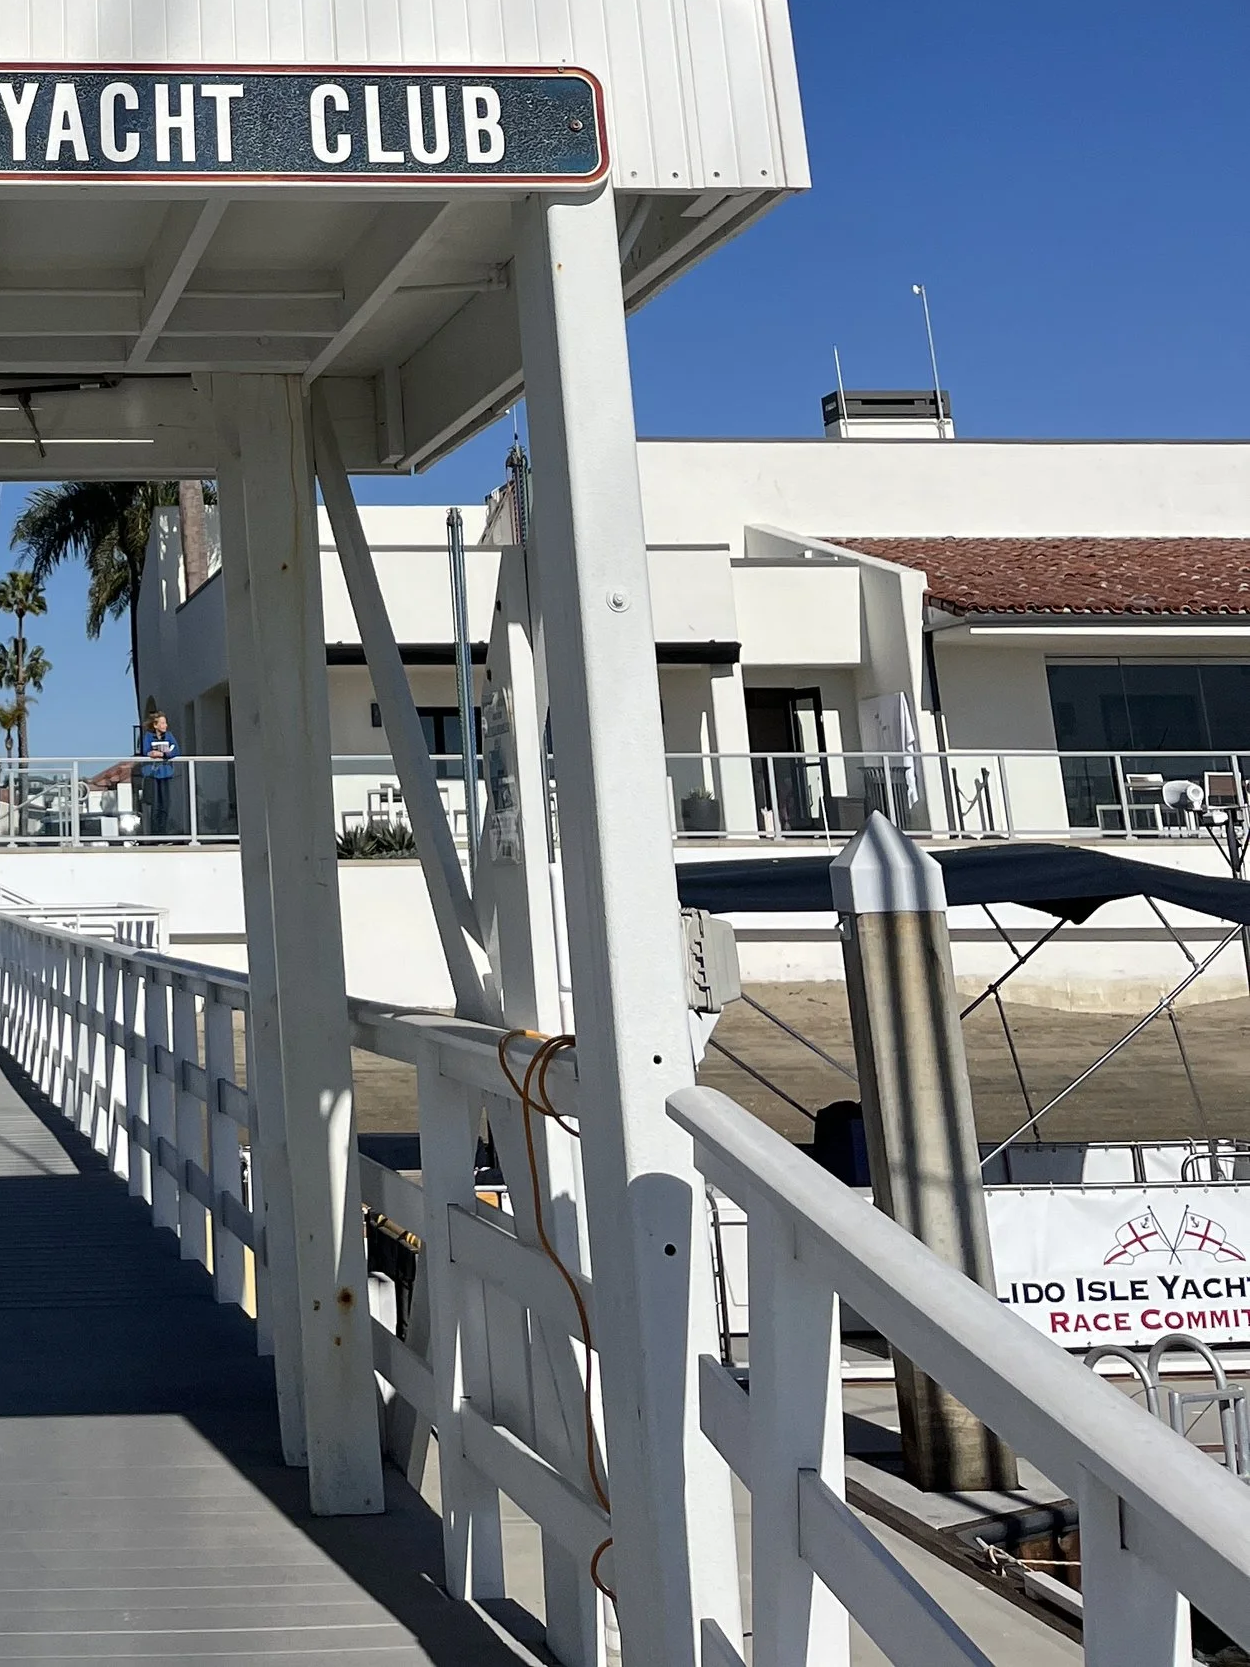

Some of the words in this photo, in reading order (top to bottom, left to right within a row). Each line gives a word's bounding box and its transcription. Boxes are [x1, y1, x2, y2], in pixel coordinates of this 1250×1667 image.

[308, 82, 506, 165] CLUB
[1076, 1277, 1149, 1302] ISLE
[1157, 1275, 1250, 1300] YACH
[1050, 1311, 1131, 1333] RACE
